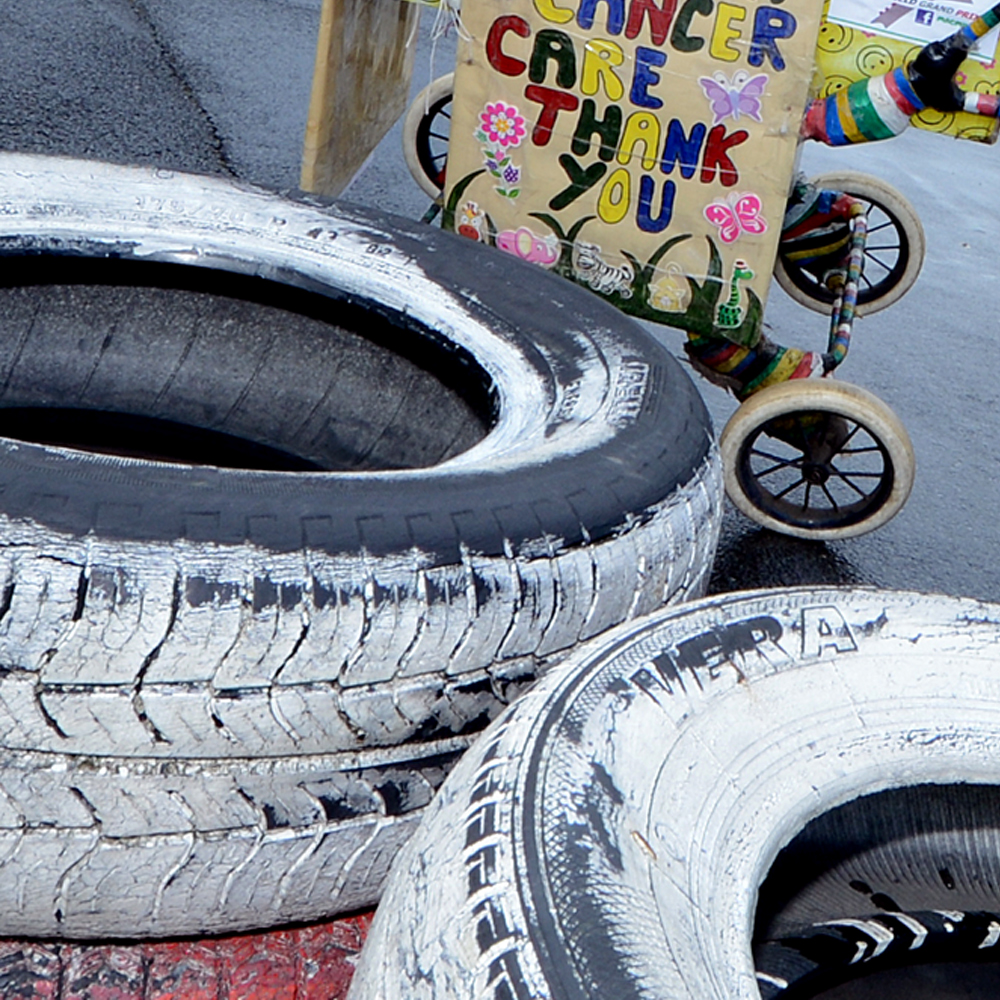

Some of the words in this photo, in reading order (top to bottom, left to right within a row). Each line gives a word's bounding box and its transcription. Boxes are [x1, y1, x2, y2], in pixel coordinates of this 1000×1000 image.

[918, 0, 955, 14] GRAND
[486, 14, 667, 109] CARE
[525, 84, 750, 186] THANK
[549, 153, 676, 233] YOU
